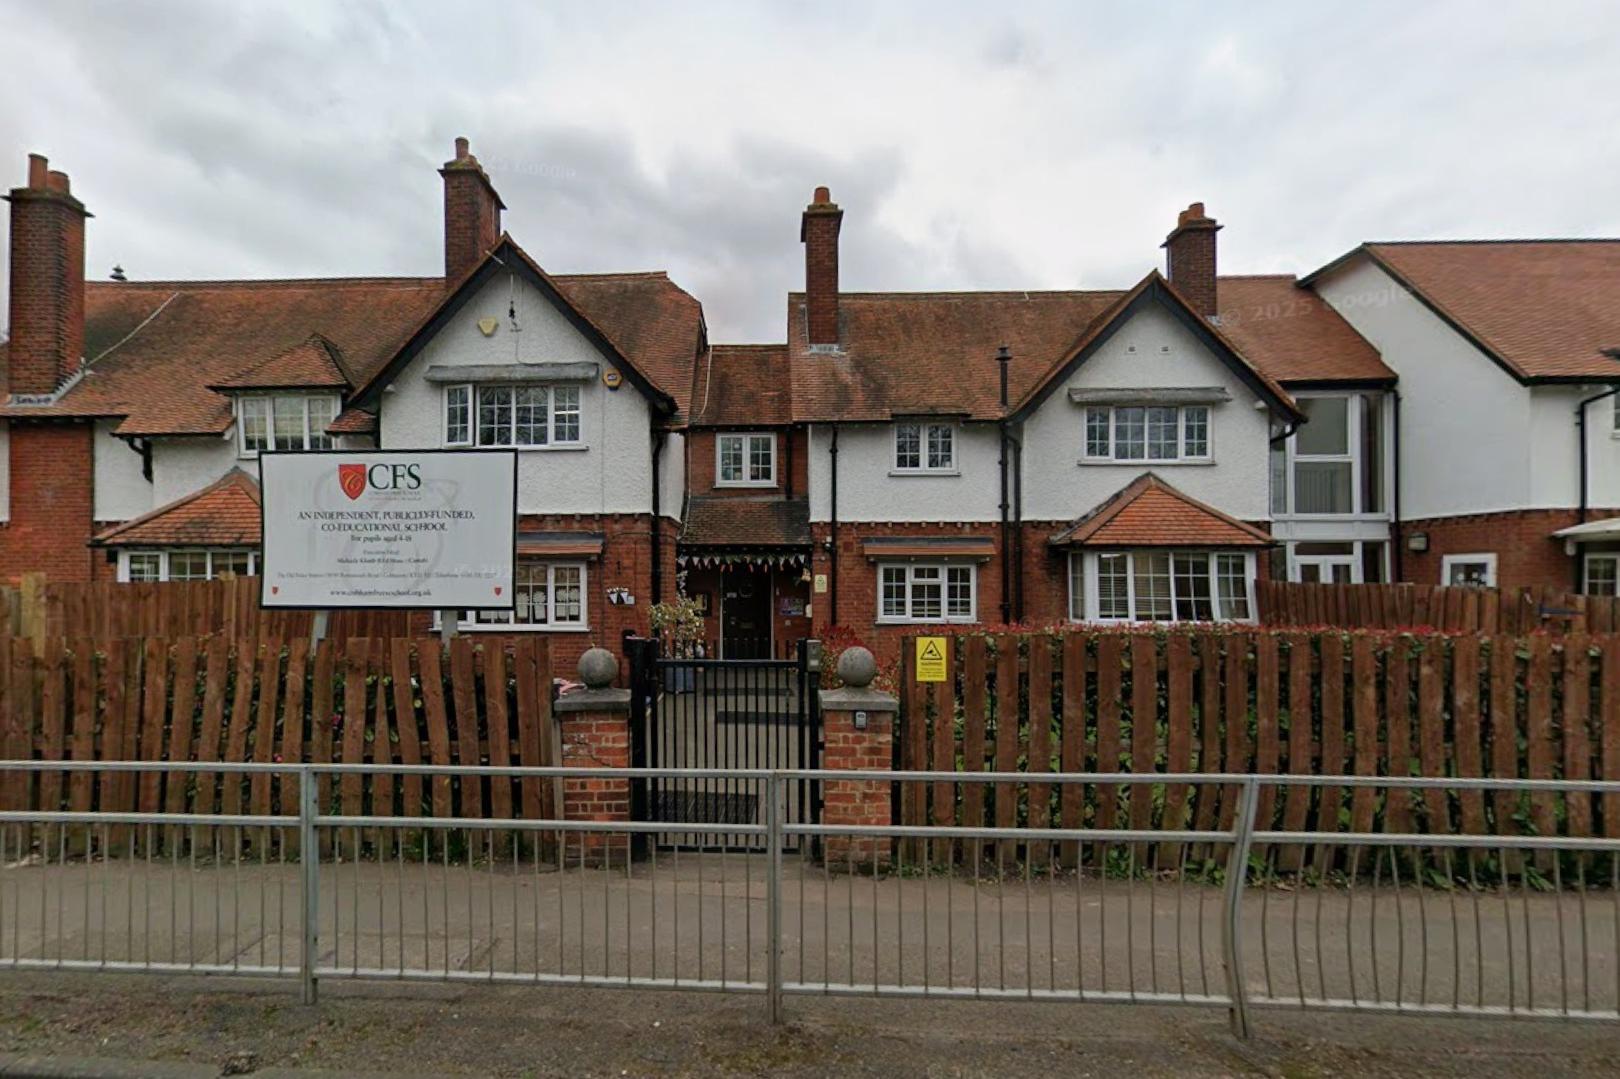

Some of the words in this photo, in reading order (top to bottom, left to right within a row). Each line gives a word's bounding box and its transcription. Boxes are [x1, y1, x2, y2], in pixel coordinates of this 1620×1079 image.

[368, 463, 422, 490] CFS
[297, 511, 312, 520] AN
[313, 511, 382, 520] INDEPENDENT,
[321, 523, 400, 532] CO-EDUCATIONAL
[404, 522, 448, 532] SCHOOL
[363, 534, 382, 543] pupils
[383, 534, 397, 543] aged
